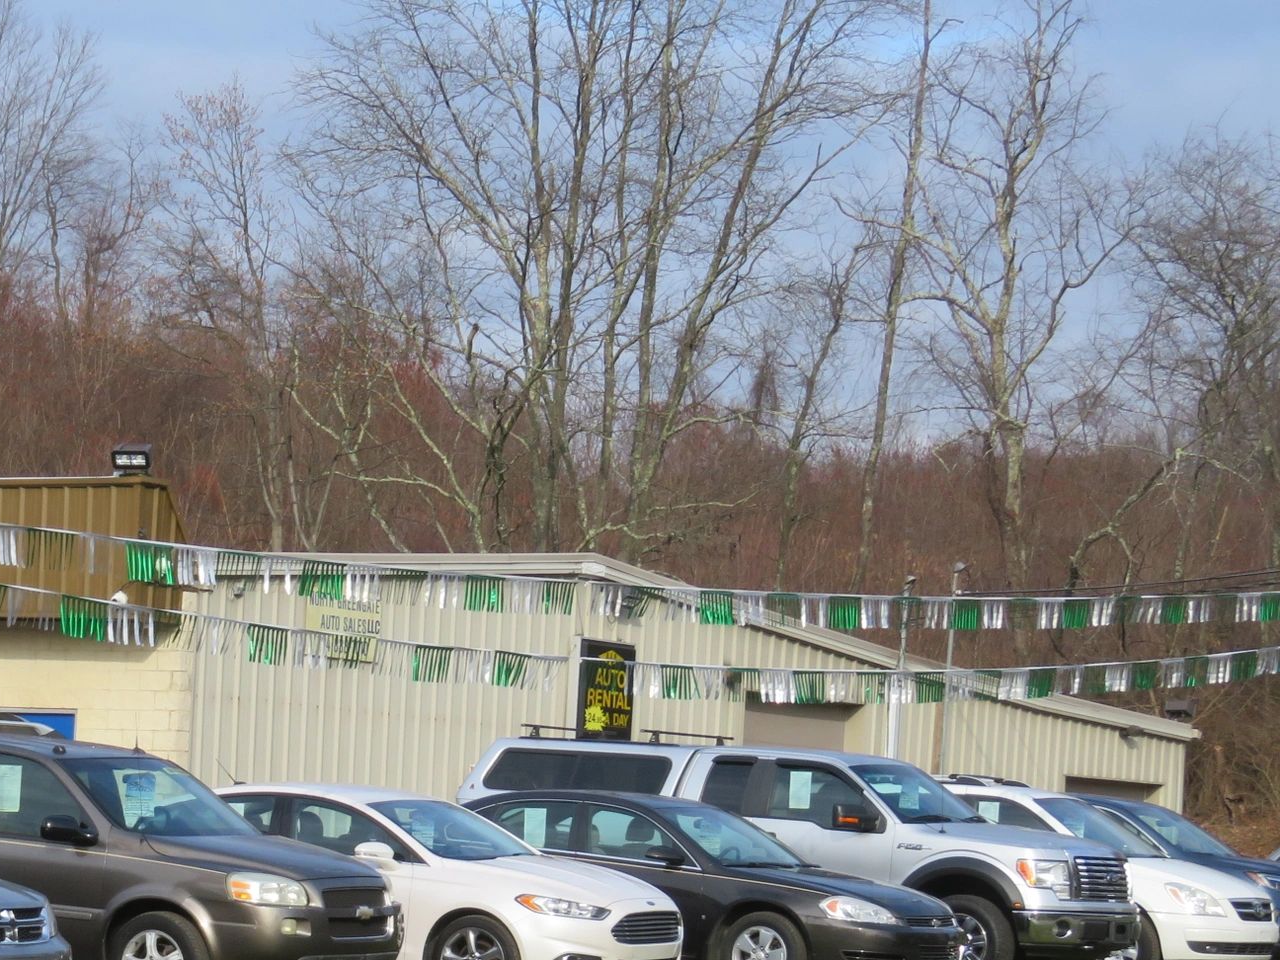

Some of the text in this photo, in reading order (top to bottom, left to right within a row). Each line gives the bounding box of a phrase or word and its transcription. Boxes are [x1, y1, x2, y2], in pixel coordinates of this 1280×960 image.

[320, 614, 380, 635] AUTO SALES LLC
[595, 667, 626, 689] AUTO
[587, 688, 631, 711] RENTAL
[613, 713, 629, 728] DAY
